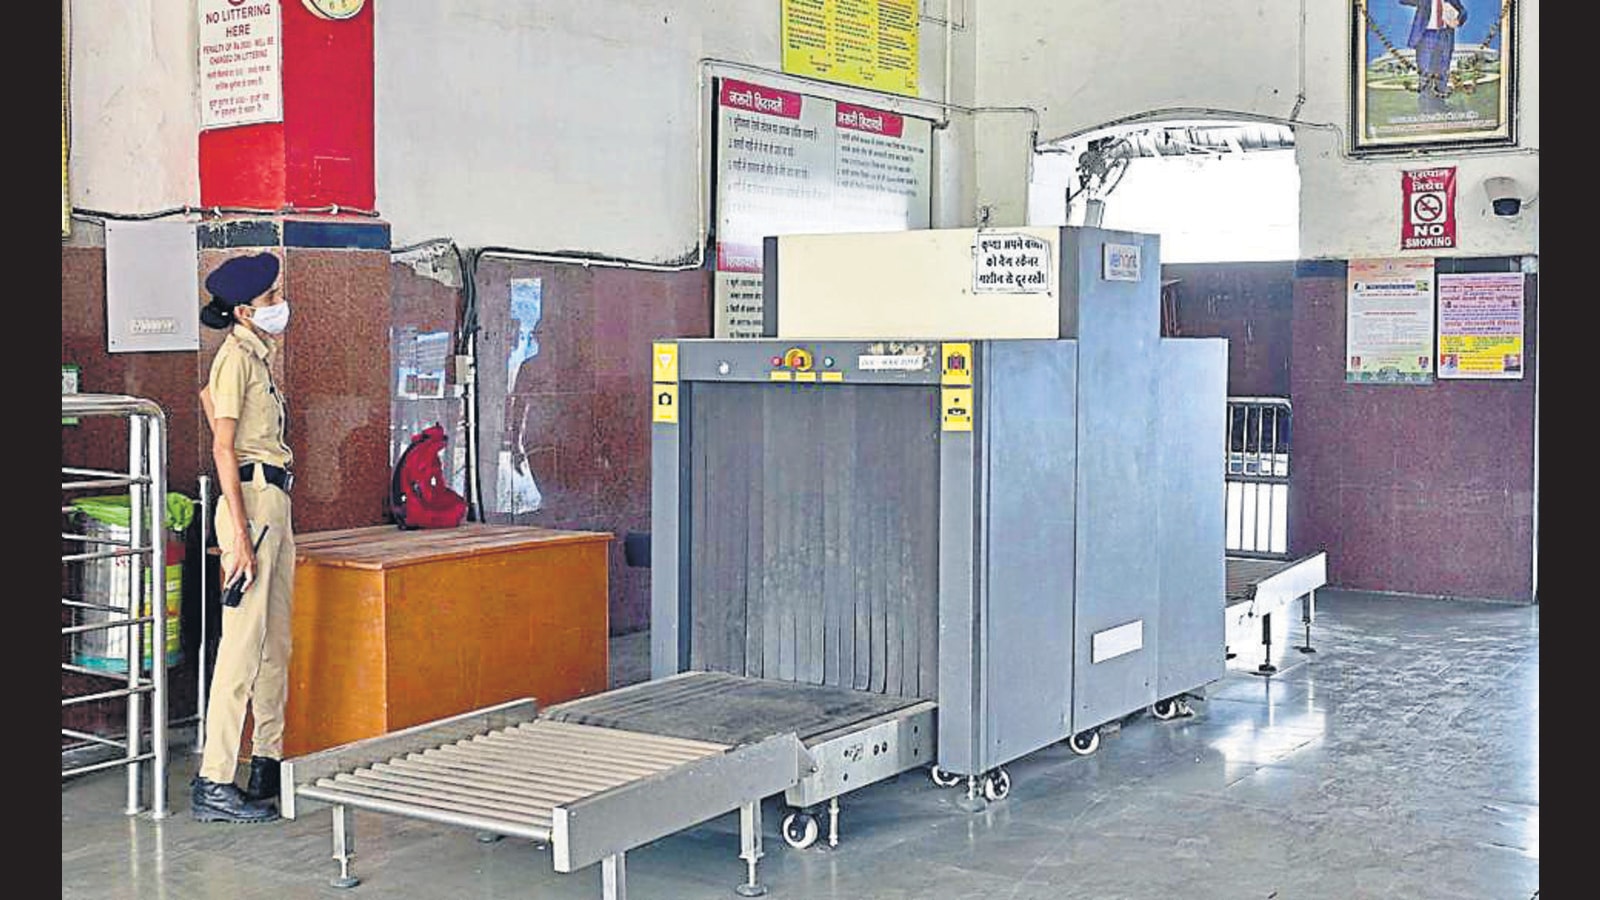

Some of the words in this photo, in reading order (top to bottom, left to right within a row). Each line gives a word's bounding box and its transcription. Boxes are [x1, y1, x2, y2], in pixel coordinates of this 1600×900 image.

[206, 12, 220, 24] NO
[222, 3, 271, 21] LITTERING
[226, 23, 251, 37] HERE
[1414, 224, 1444, 237] NO
[1406, 236, 1452, 248] SMOKING
[986, 253, 997, 267] को
[979, 271, 1004, 284] मशीन
[1006, 271, 1014, 284] से
[1015, 274, 1026, 289] दूर
